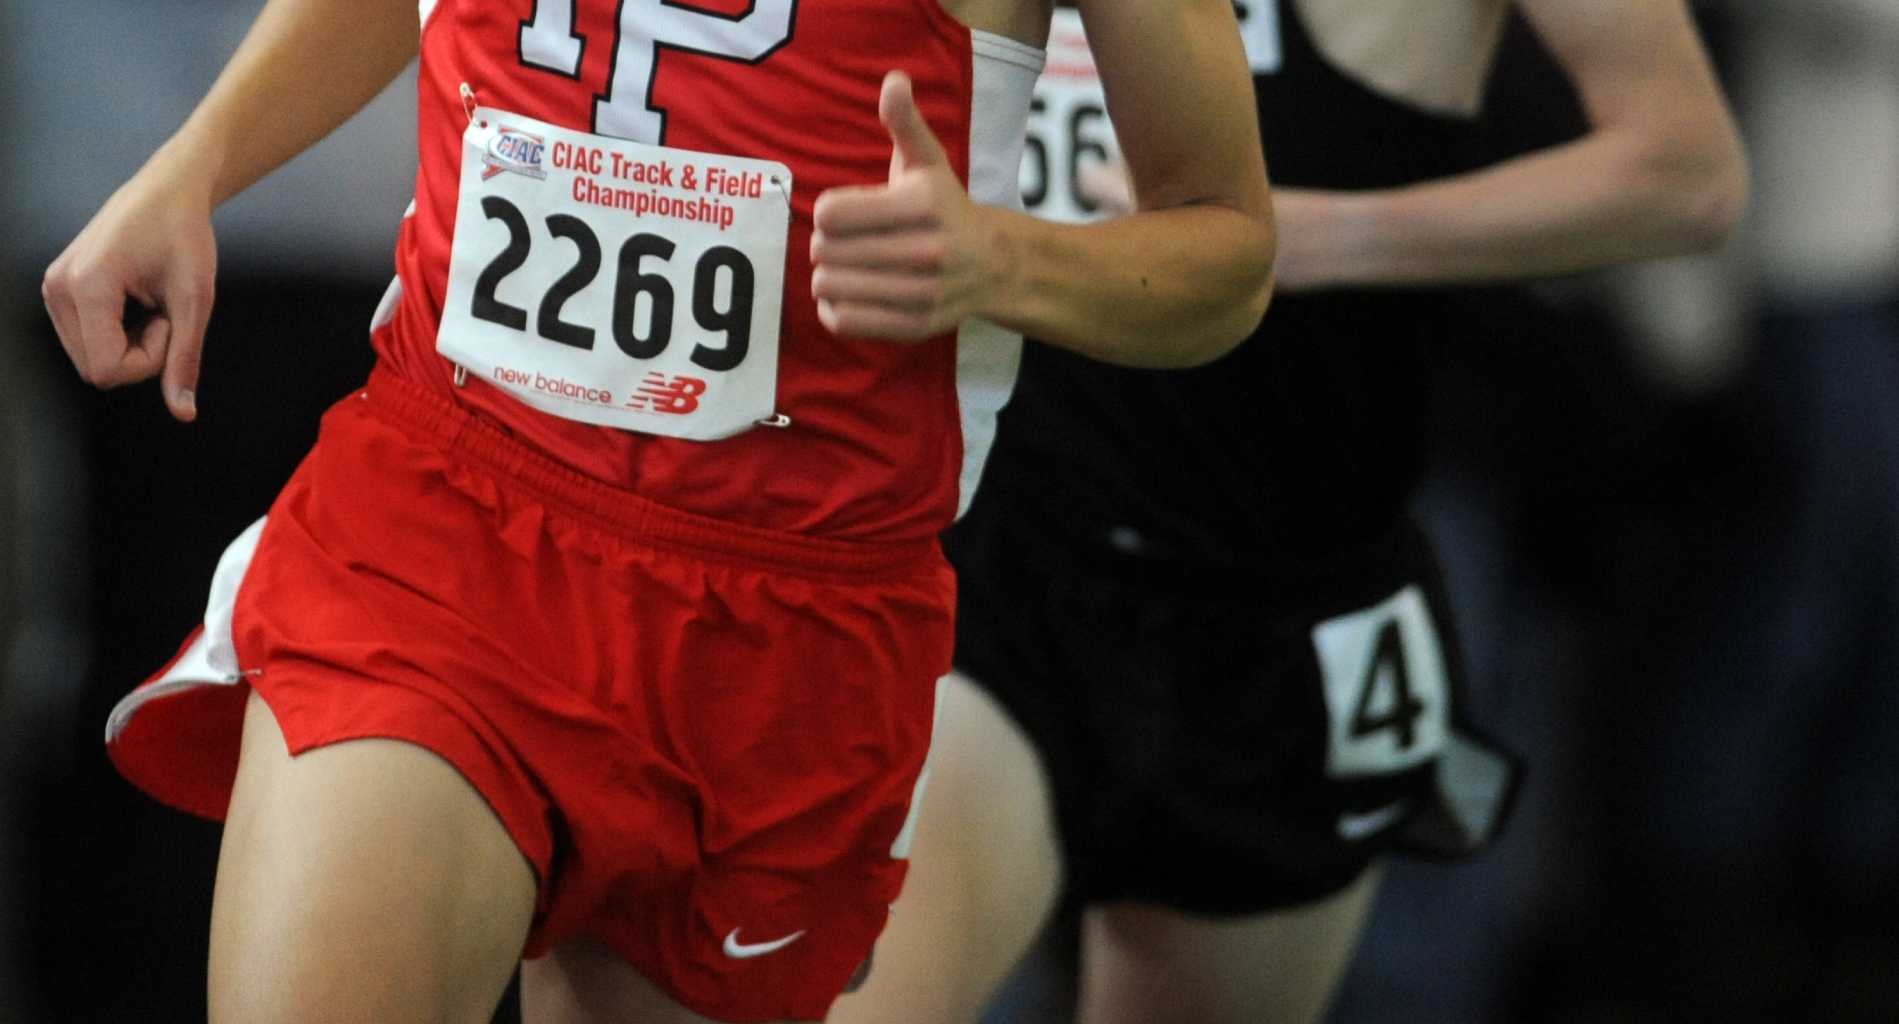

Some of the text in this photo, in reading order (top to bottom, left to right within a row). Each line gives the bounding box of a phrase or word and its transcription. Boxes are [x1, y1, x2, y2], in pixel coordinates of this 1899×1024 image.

[496, 135, 545, 165] CIAC
[551, 141, 763, 199] CIAC Track & Field
[572, 178, 734, 232] Championship
[470, 195, 755, 372] 2269
[493, 365, 531, 386] new
[534, 372, 613, 404] balance
[1349, 616, 1424, 751] 4
